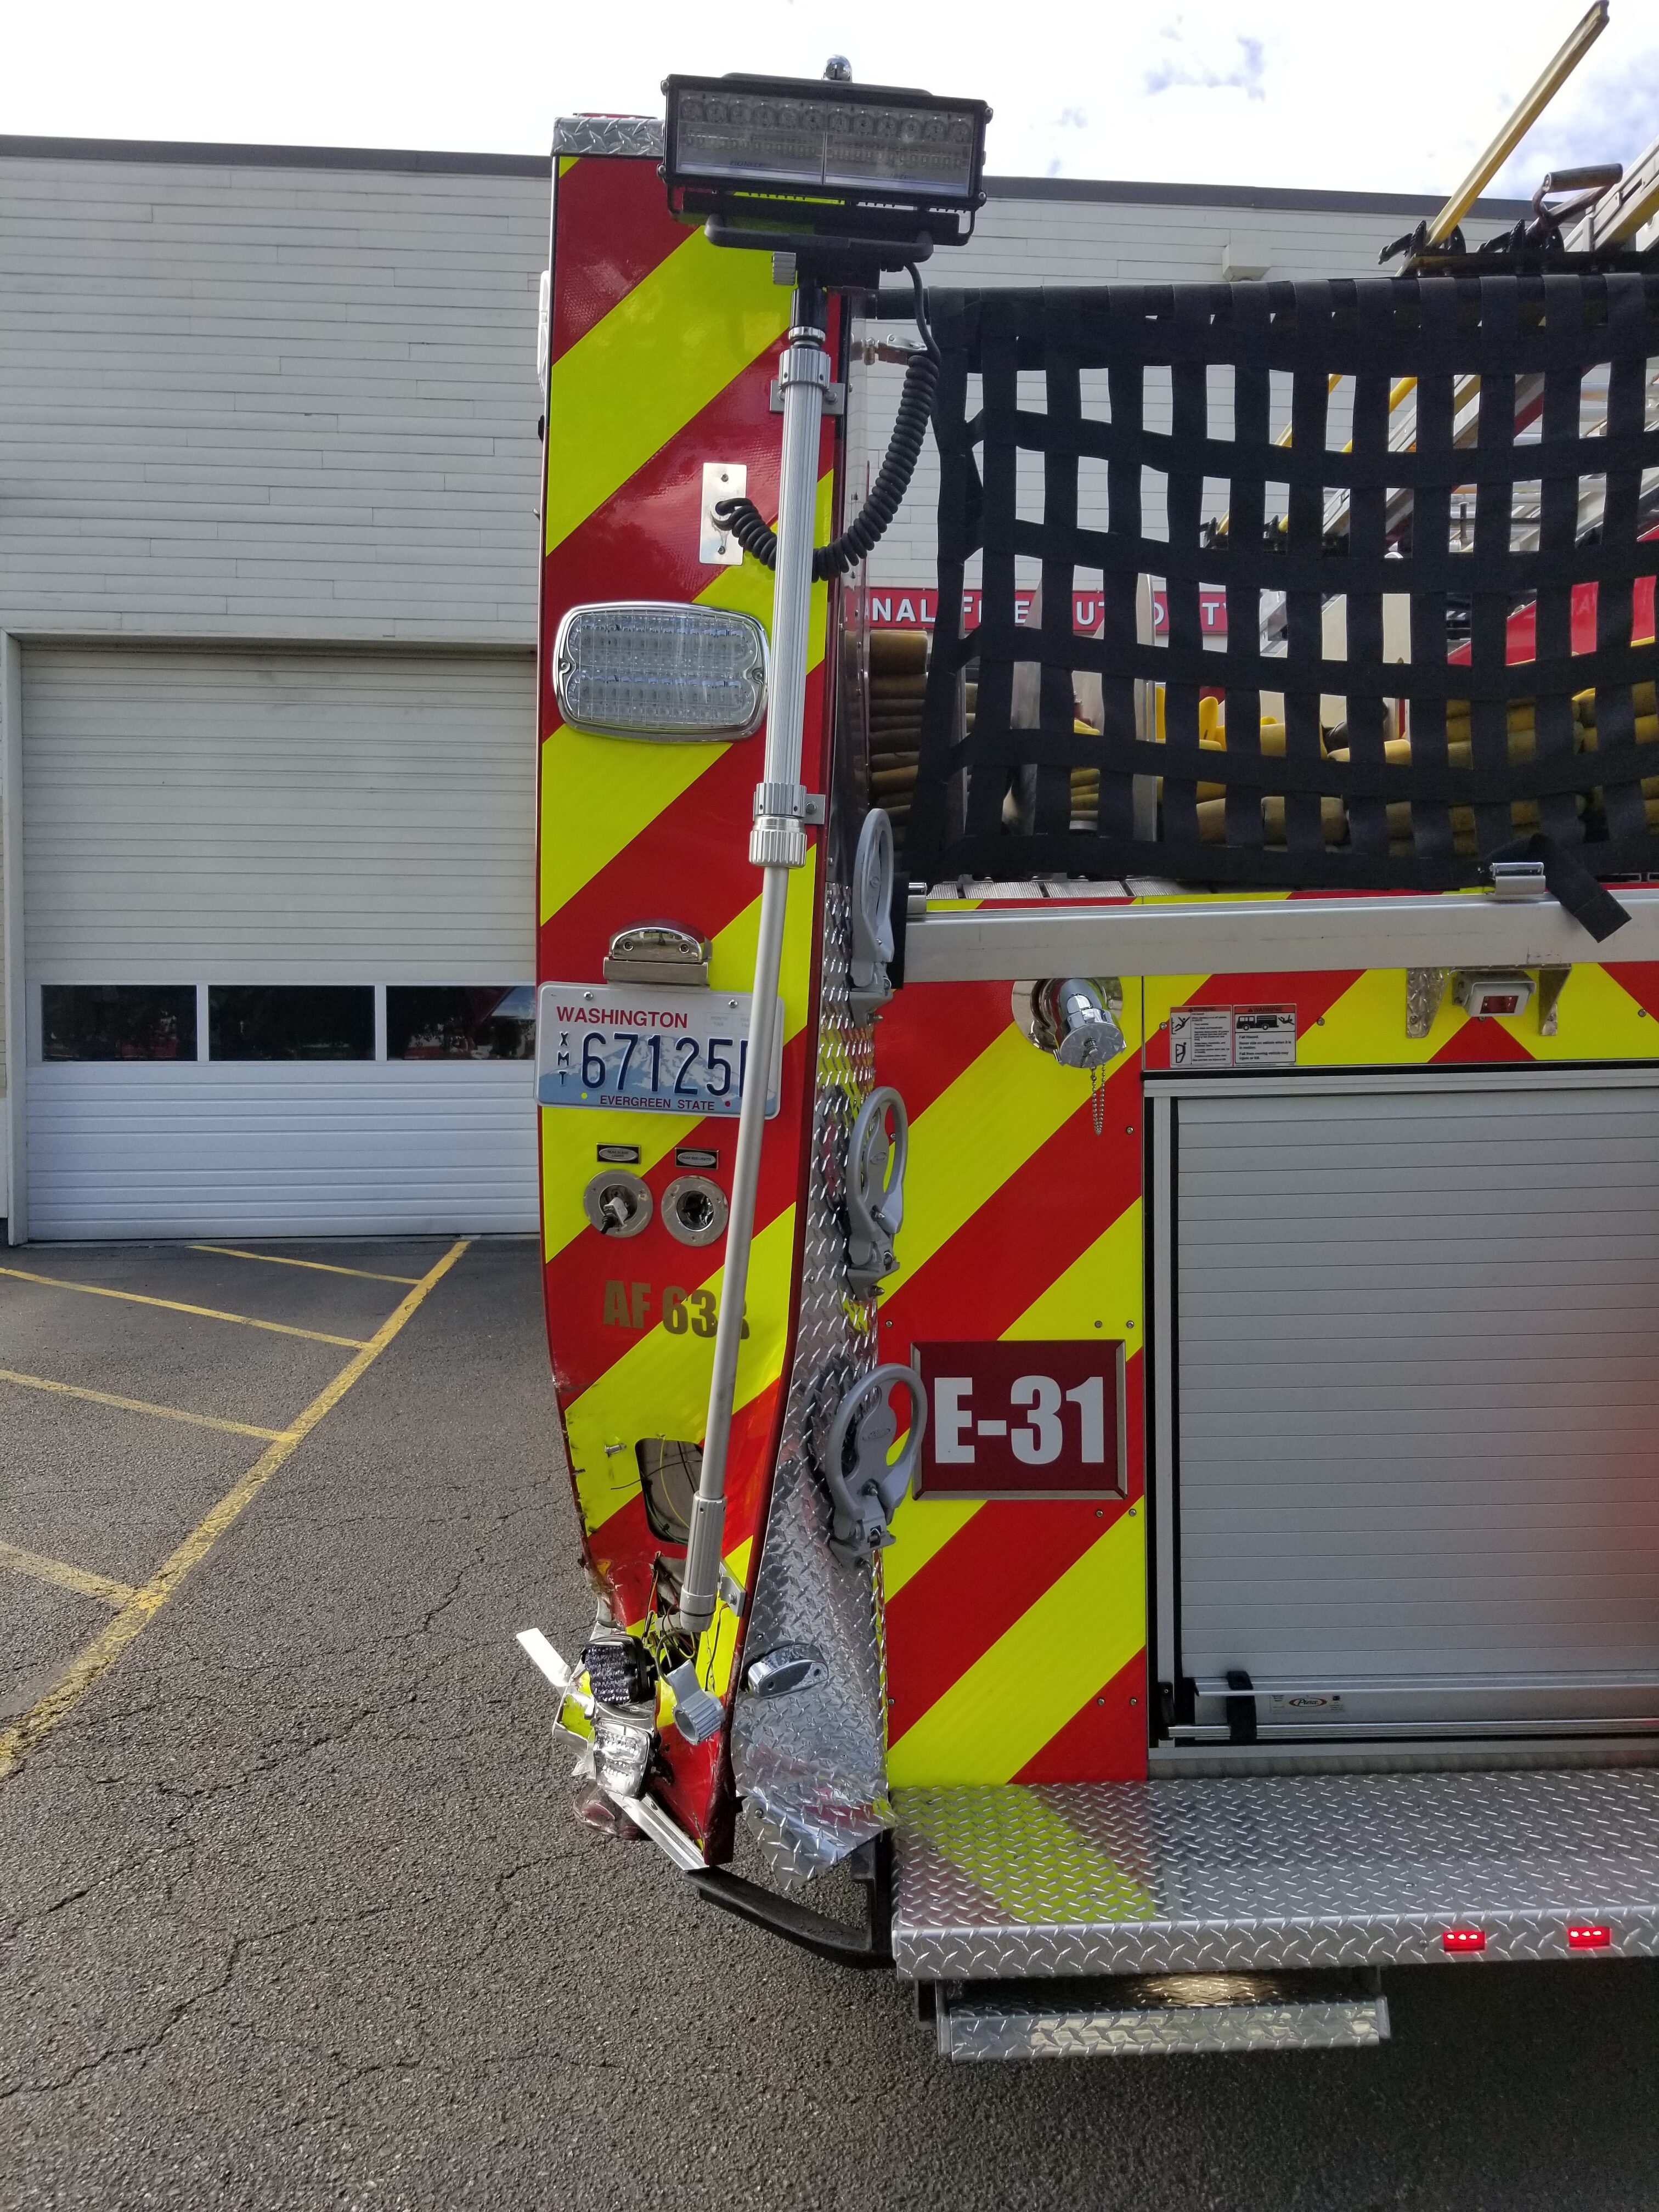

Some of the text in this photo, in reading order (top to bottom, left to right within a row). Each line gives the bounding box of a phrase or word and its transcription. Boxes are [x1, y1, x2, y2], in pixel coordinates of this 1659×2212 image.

[557, 1006, 688, 1029] WASHINGTON
[600, 1094, 715, 1111] EVERGREEN STATE
[603, 1279, 750, 1340] AF 63
[934, 1375, 1104, 1465] E-31
